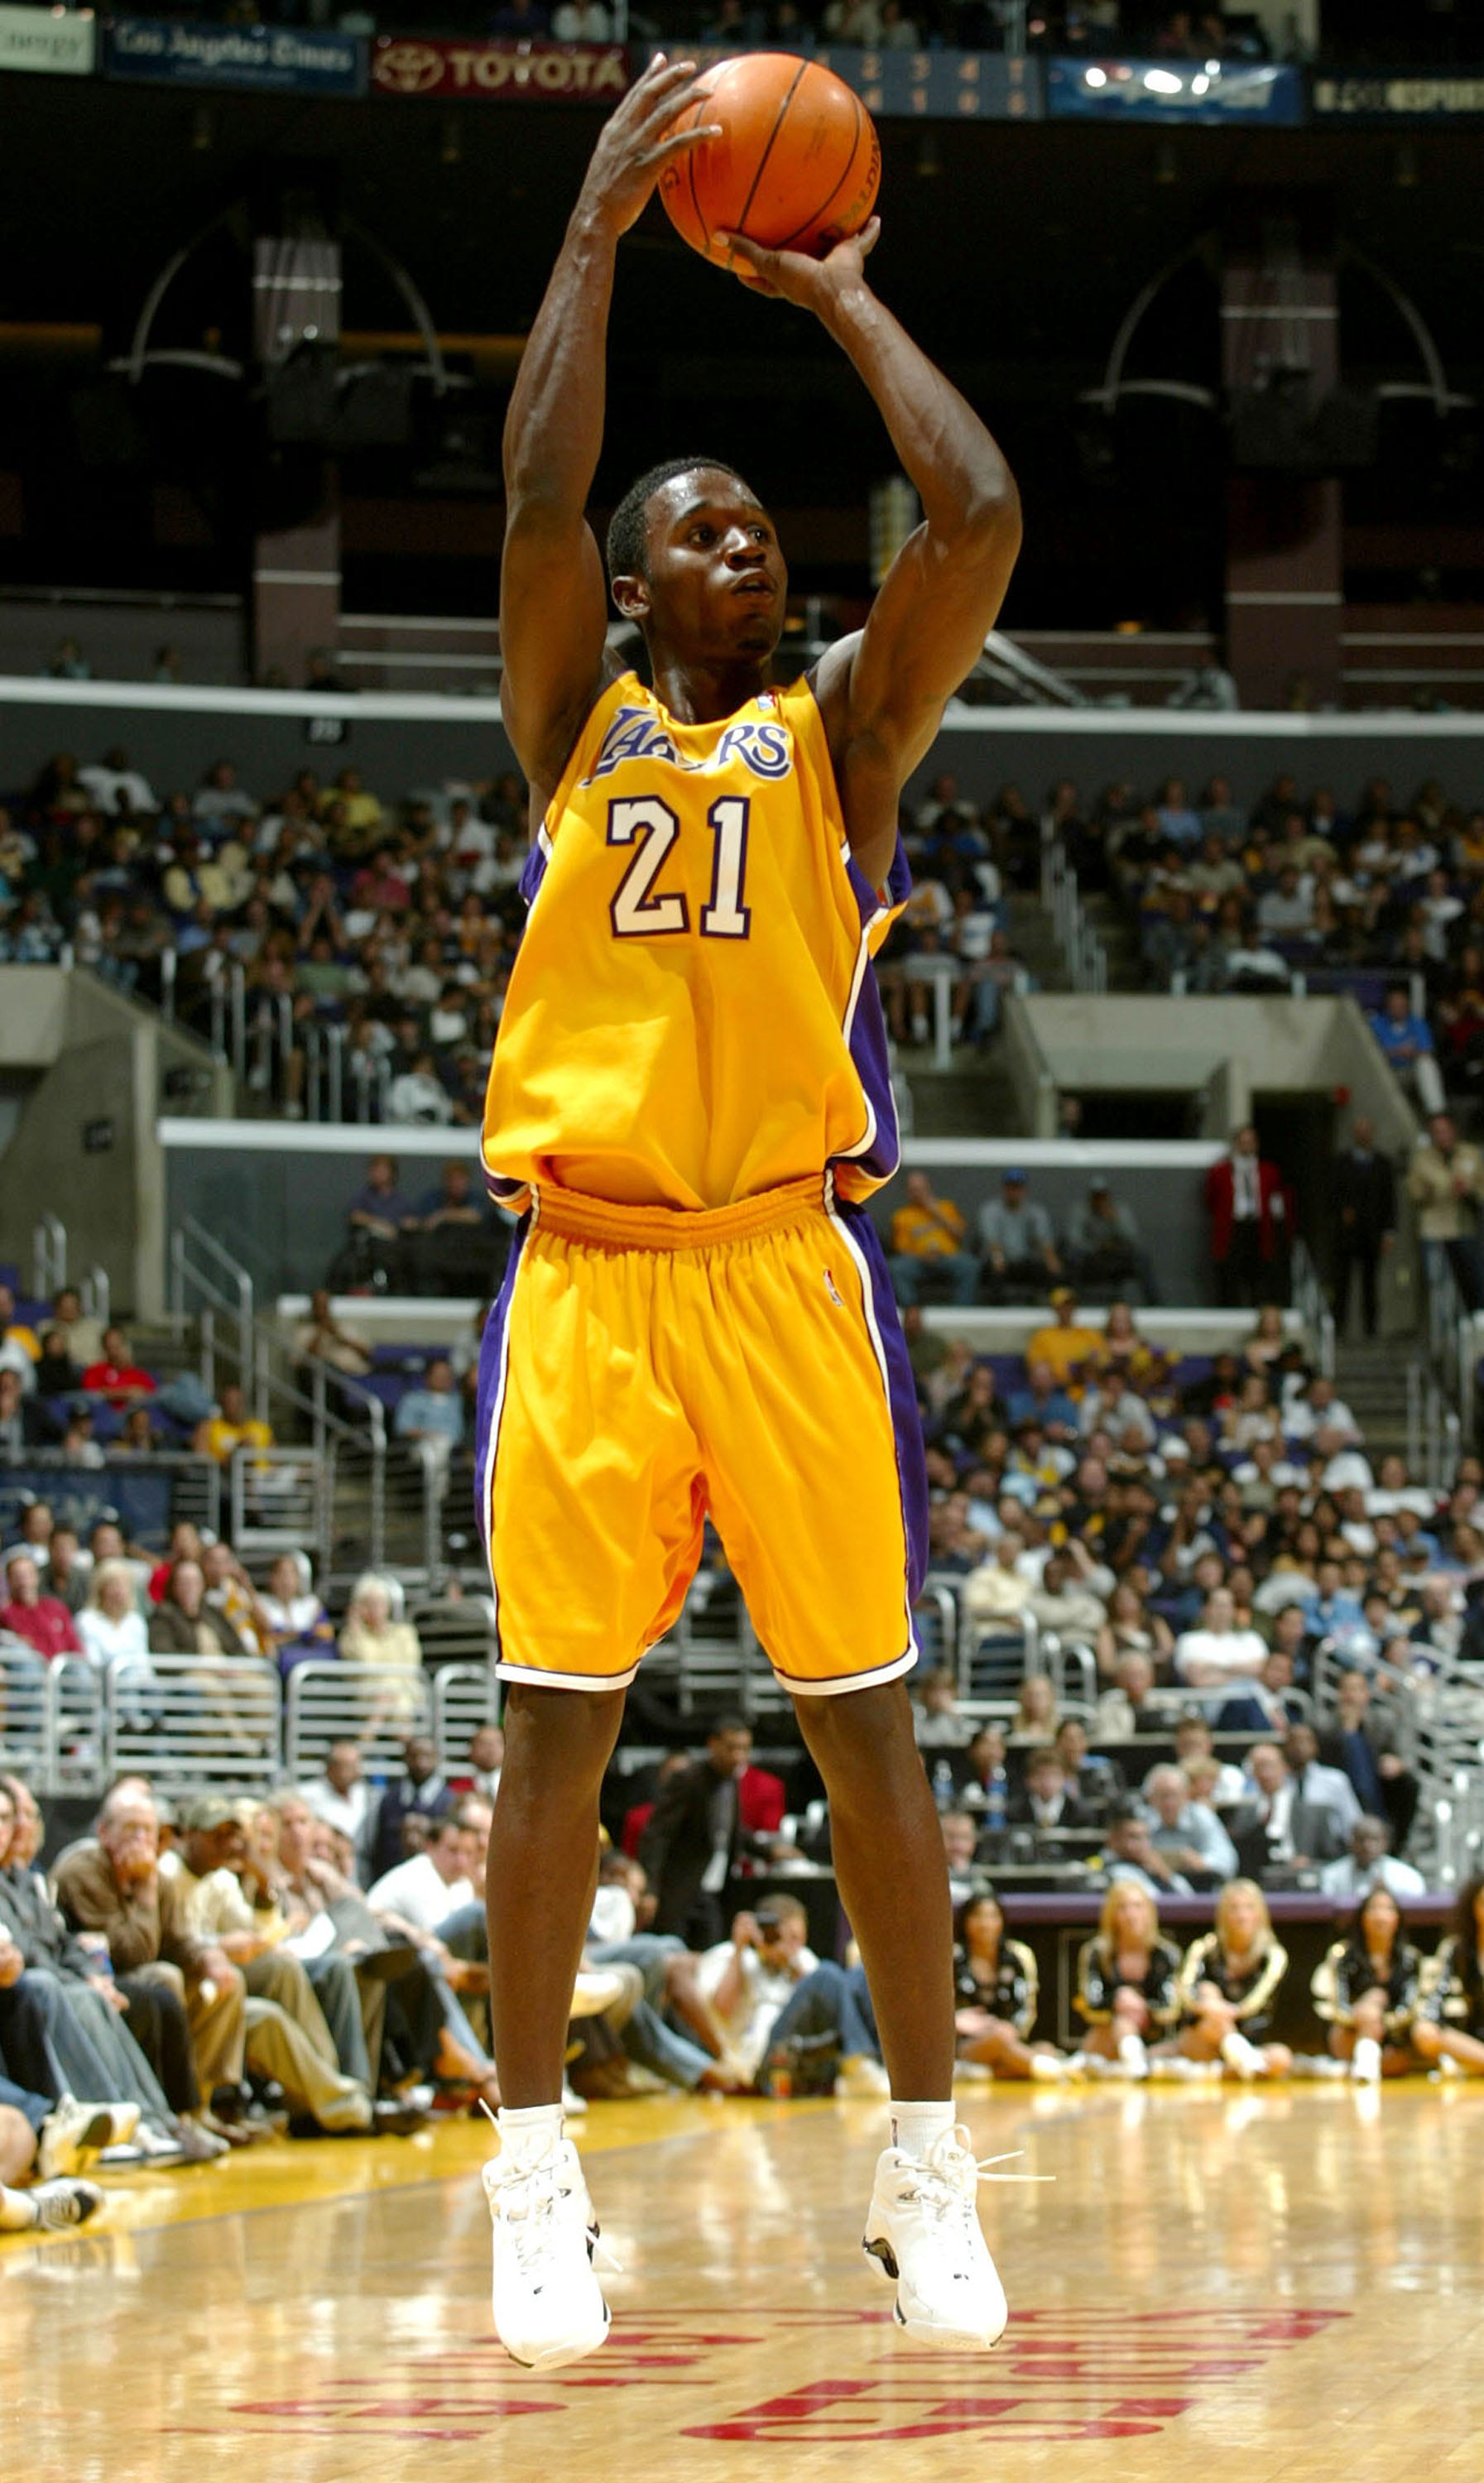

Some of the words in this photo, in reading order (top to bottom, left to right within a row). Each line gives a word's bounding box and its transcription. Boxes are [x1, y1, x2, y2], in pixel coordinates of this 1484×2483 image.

[448, 50, 627, 90] TOYOTA
[581, 706, 792, 786] LARS
[606, 795, 752, 940] 21
[680, 2306, 1352, 2442] STAPLES
